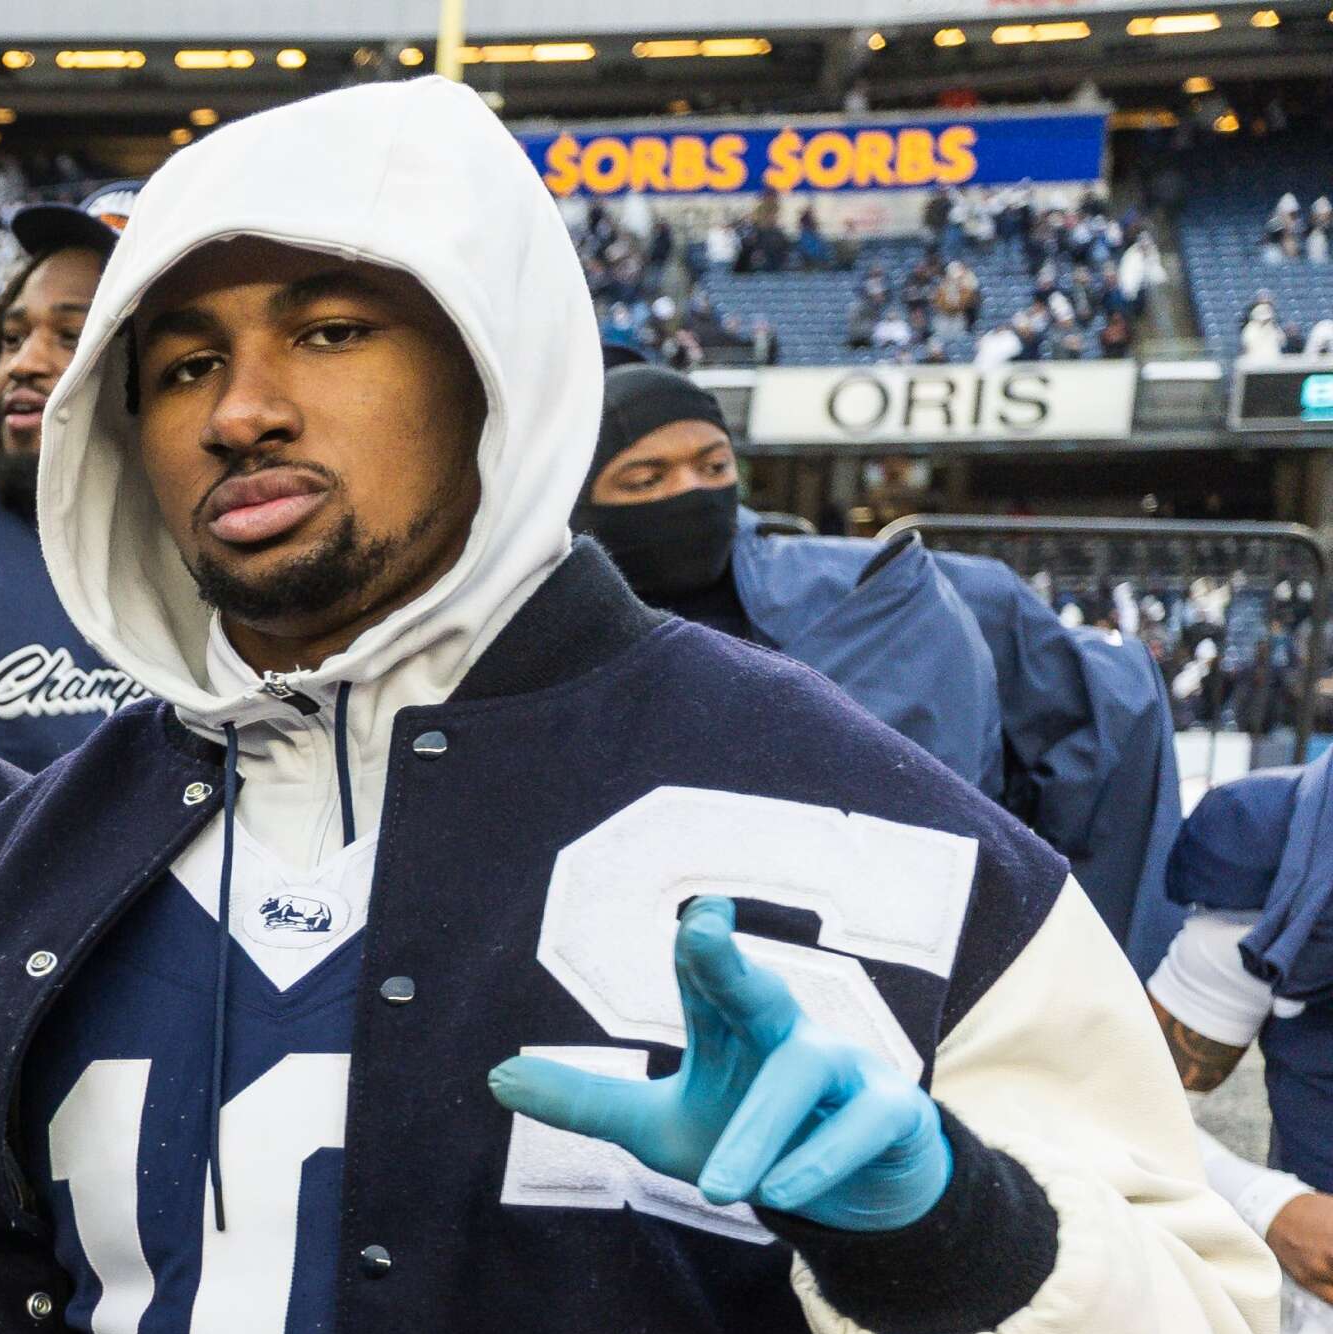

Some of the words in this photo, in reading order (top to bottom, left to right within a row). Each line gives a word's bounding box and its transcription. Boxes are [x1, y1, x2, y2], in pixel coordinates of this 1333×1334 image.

[544, 130, 748, 198] $ORBS
[763, 125, 977, 192] $ORBS
[827, 370, 1051, 435] ORIS
